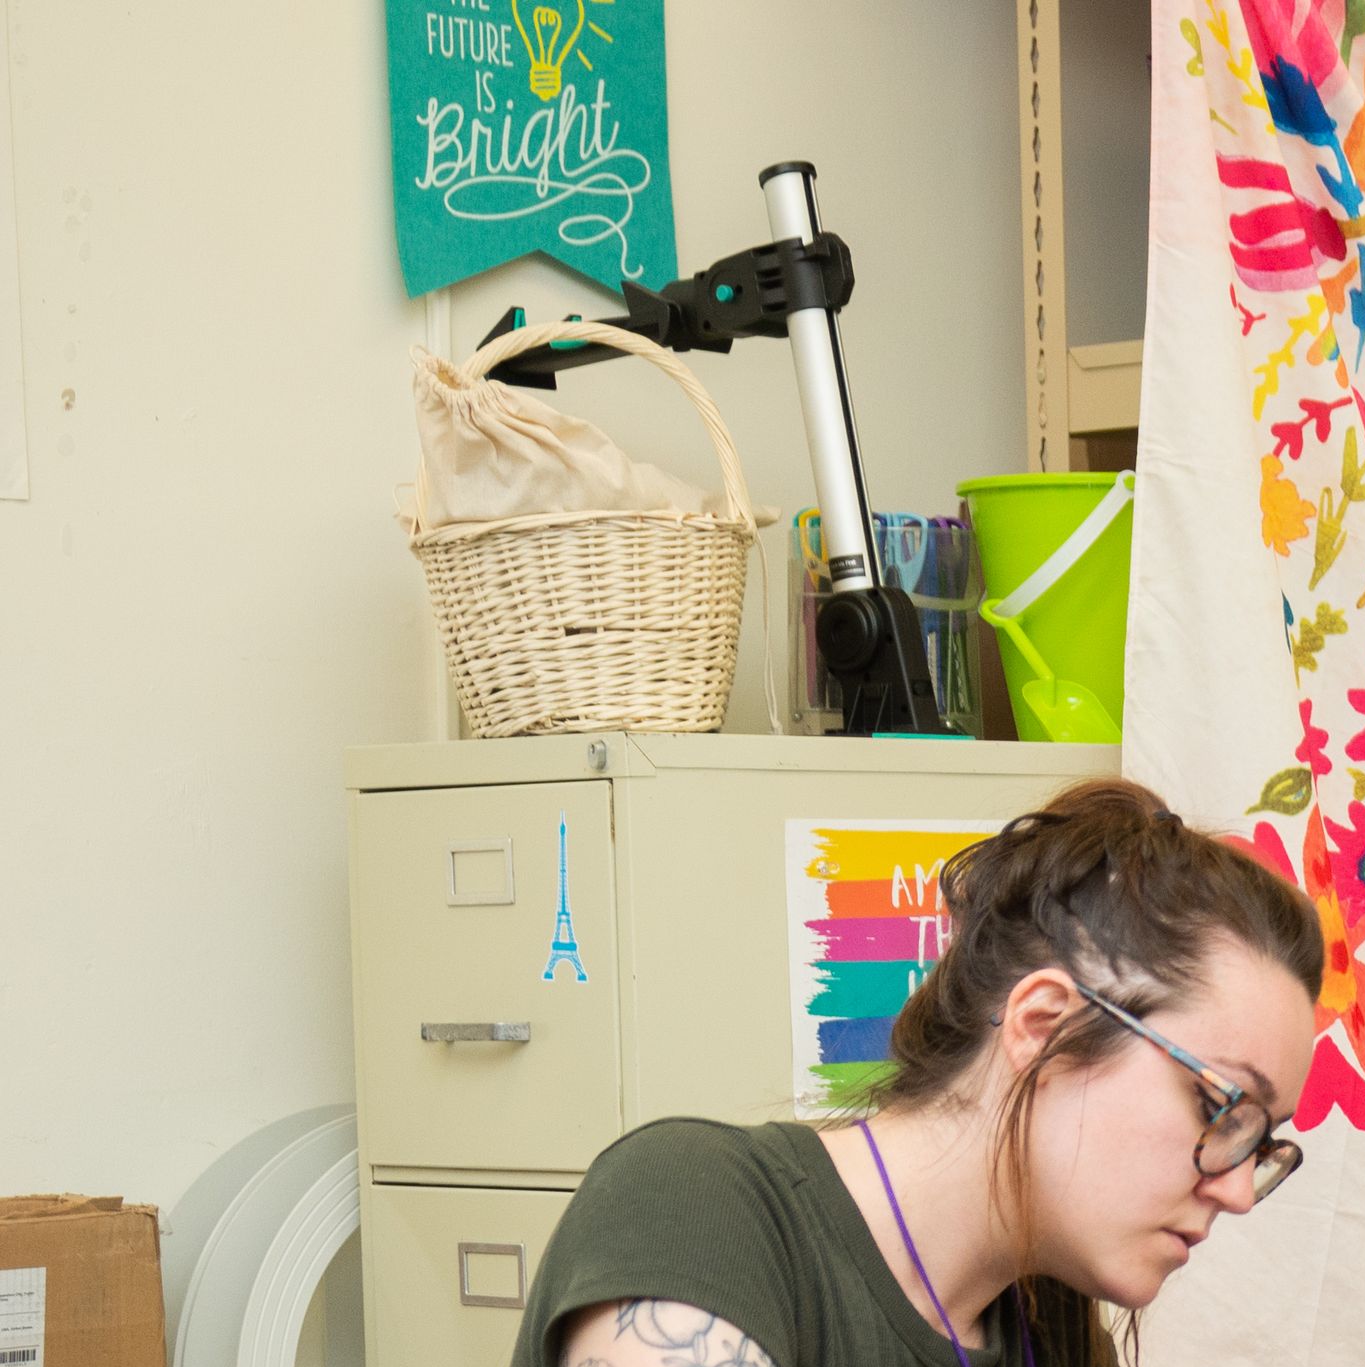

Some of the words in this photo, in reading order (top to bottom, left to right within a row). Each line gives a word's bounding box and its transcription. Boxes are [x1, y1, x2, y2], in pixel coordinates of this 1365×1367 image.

[426, 13, 514, 67] FUTURE
[475, 70, 496, 113] IS
[414, 79, 621, 199] Bright
